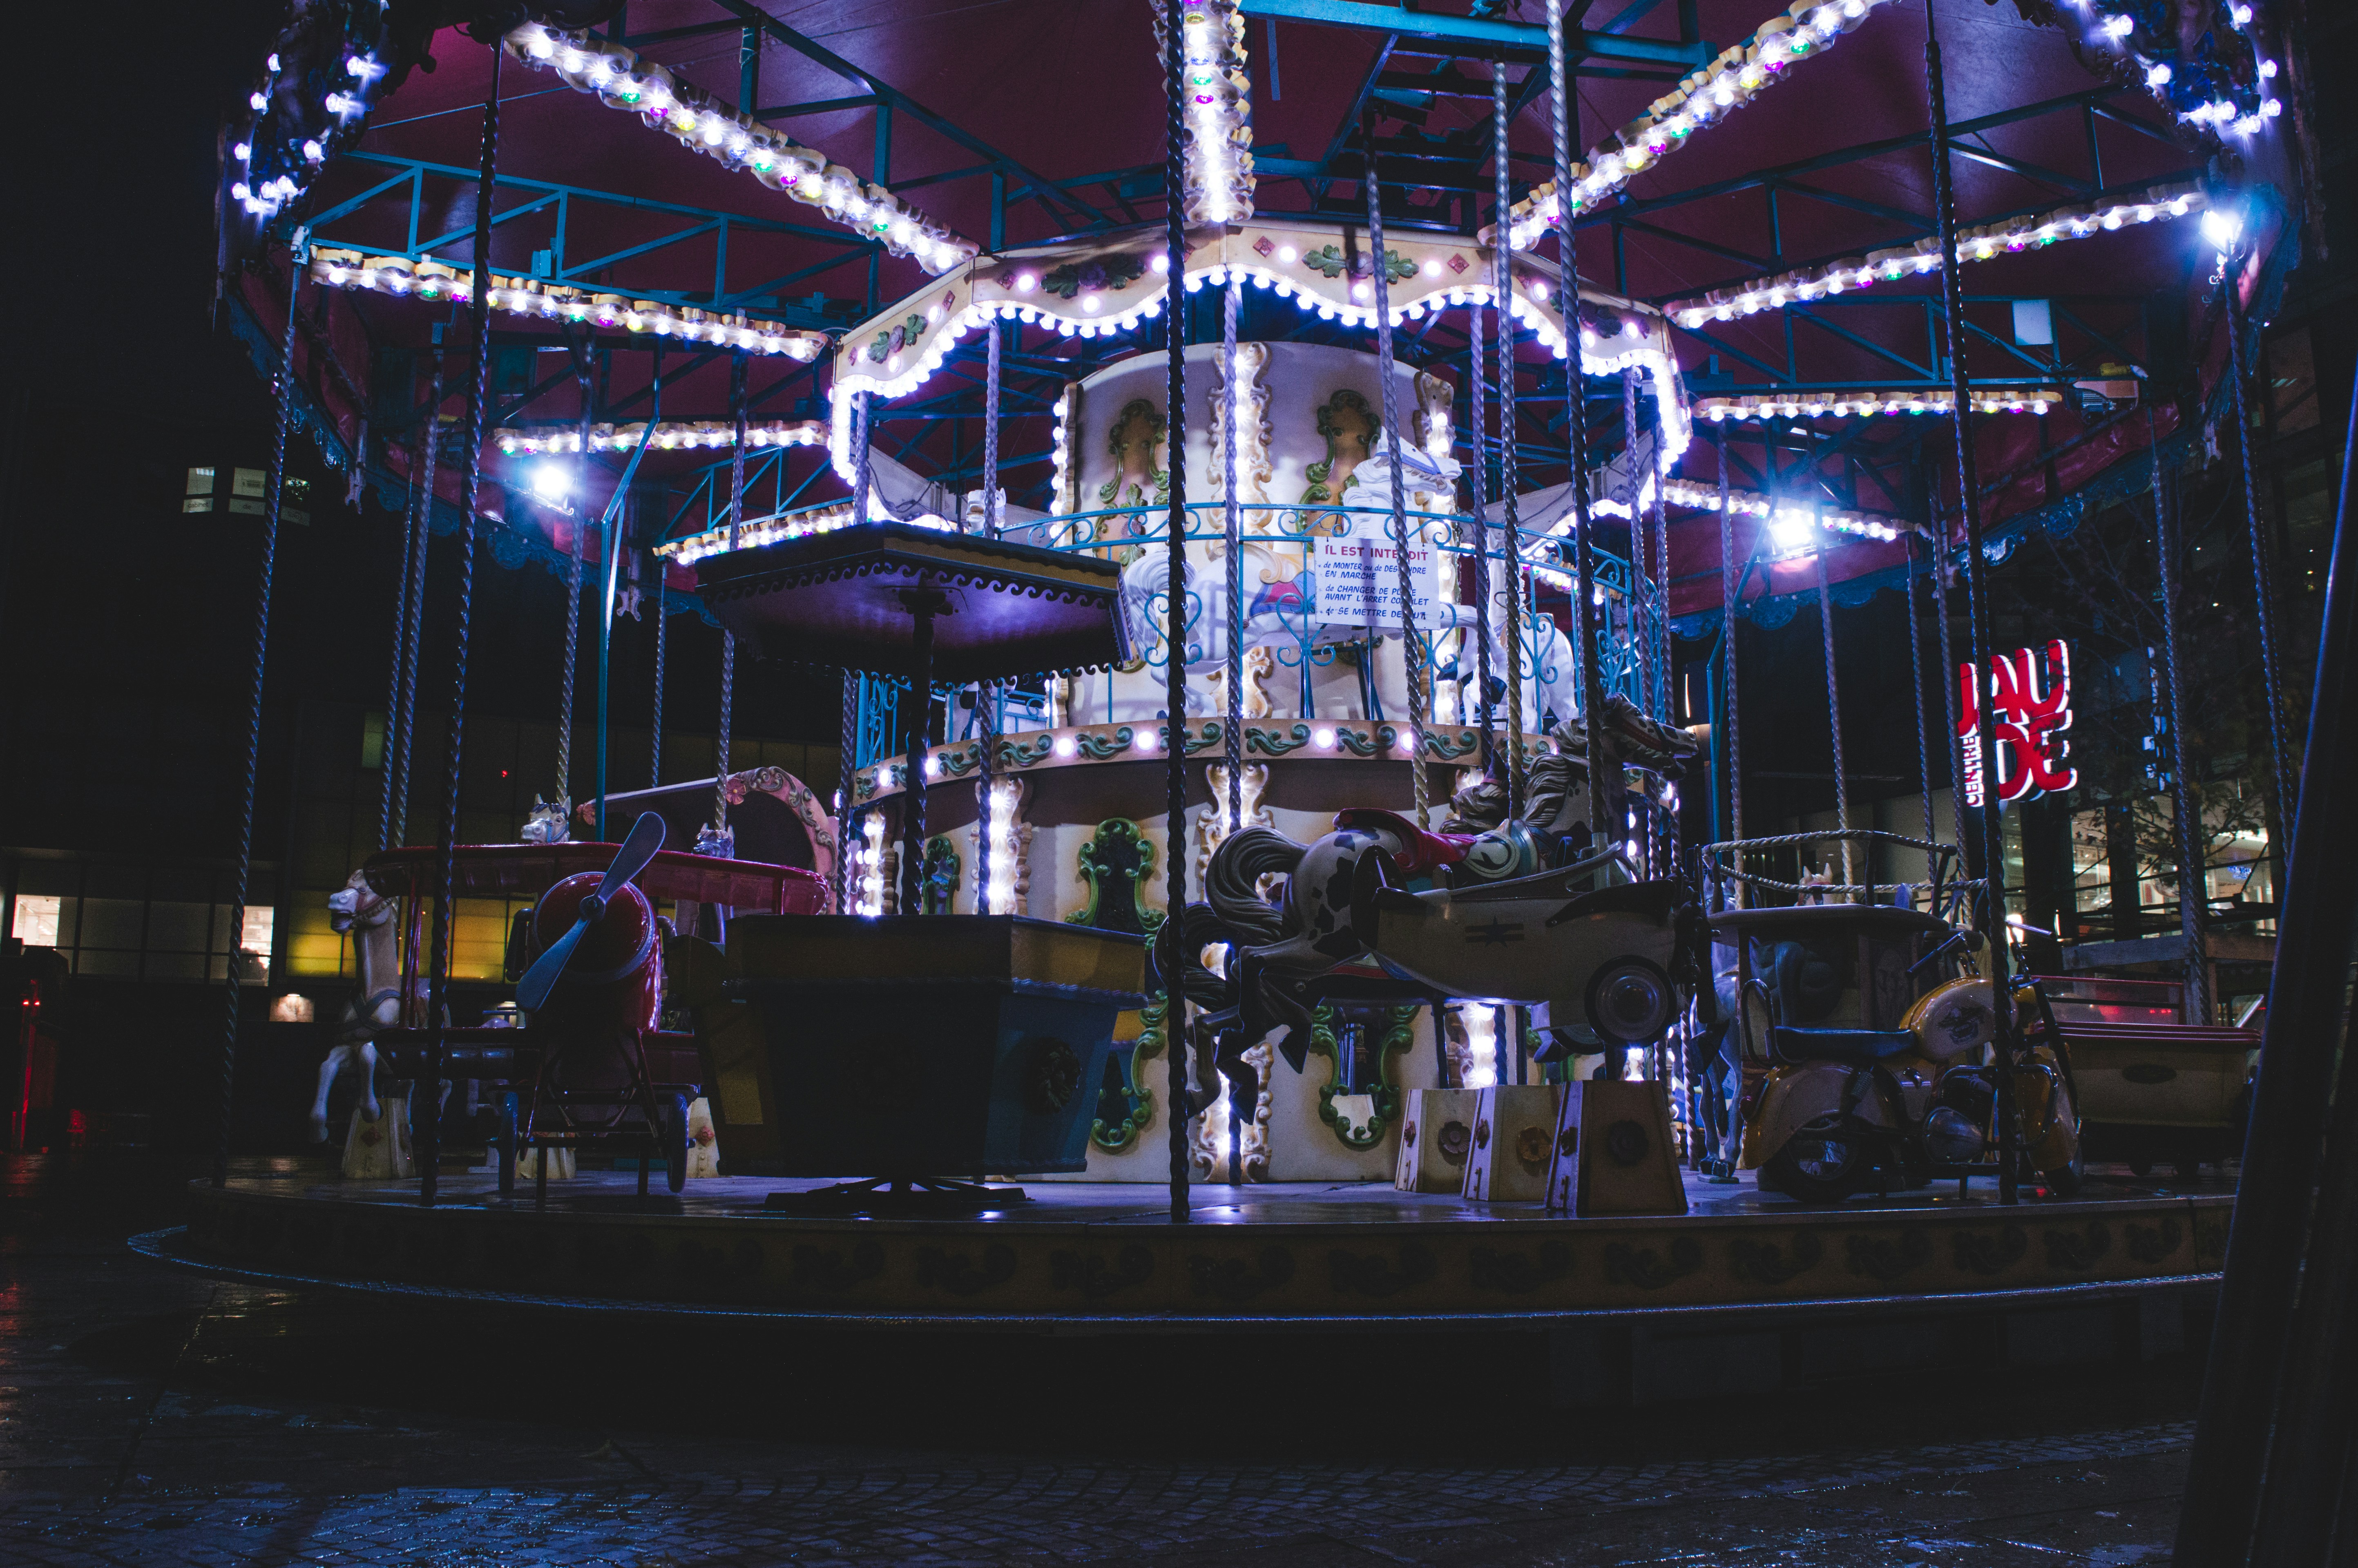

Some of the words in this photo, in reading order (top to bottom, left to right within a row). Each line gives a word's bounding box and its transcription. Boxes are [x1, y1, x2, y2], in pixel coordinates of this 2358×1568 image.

[1325, 545, 1337, 555] IL
[1341, 546, 1364, 556] EST
[1371, 548, 1428, 561] INTEDIT
[1333, 562, 1362, 570] MONTER
[1384, 565, 1426, 574] DESDRE
[1341, 572, 1376, 580] MARCHE
[1337, 585, 1376, 594] CHANGER
[1356, 595, 1387, 603] L'ARRET
[1391, 597, 1429, 605] COLET
[1353, 608, 1387, 617] METTRE
[1962, 736, 1984, 807] CENTRE
